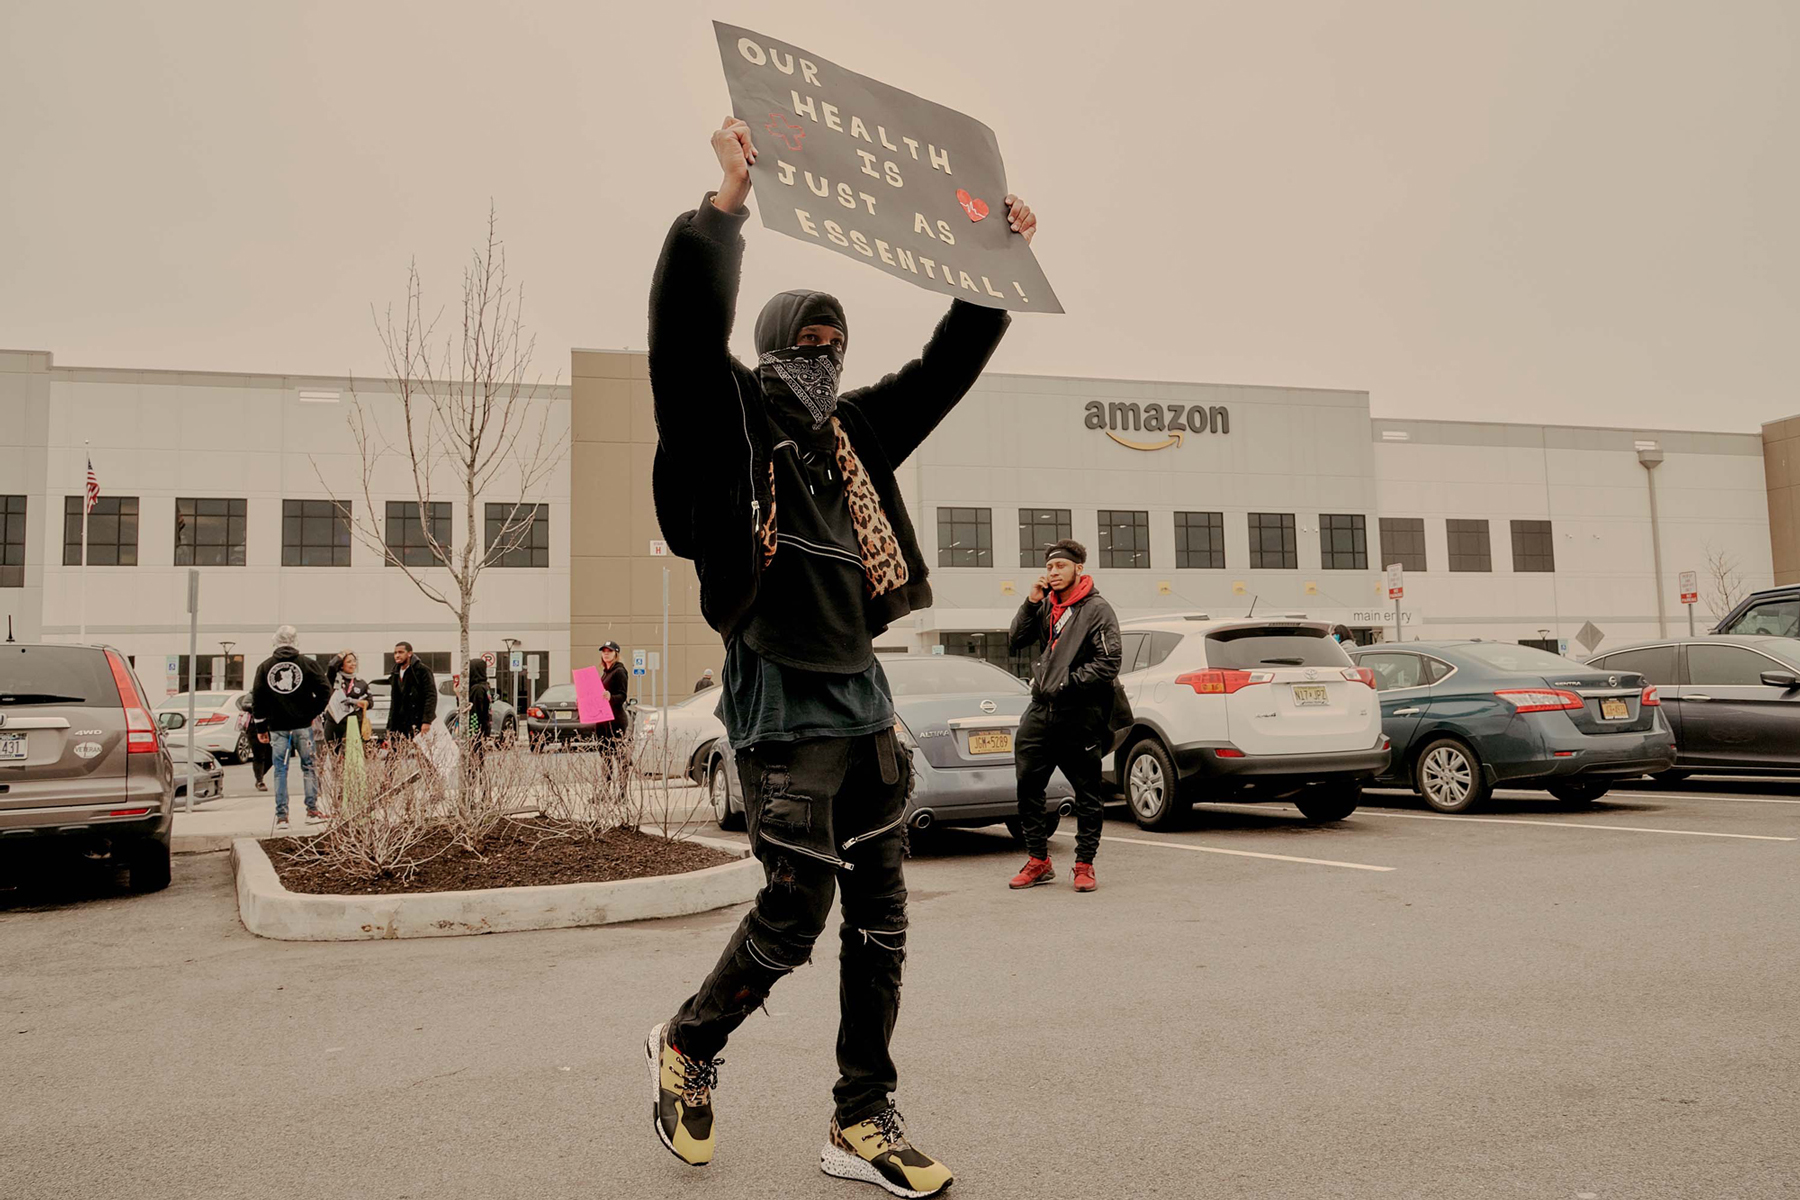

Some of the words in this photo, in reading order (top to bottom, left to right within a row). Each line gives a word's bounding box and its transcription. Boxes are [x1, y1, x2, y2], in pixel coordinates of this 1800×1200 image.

[738, 37, 821, 87] OUR
[790, 89, 953, 175] HEALTH
[856, 148, 904, 188] IS
[777, 159, 876, 216] JUST
[913, 212, 956, 246] AS
[1084, 400, 1230, 434] amazon
[1353, 610, 1380, 621] main
[1384, 612, 1412, 624] enry
[2, 741, 20, 754] 431
[75, 745, 102, 753] VETERAN
[920, 730, 950, 738] ALTIMA
